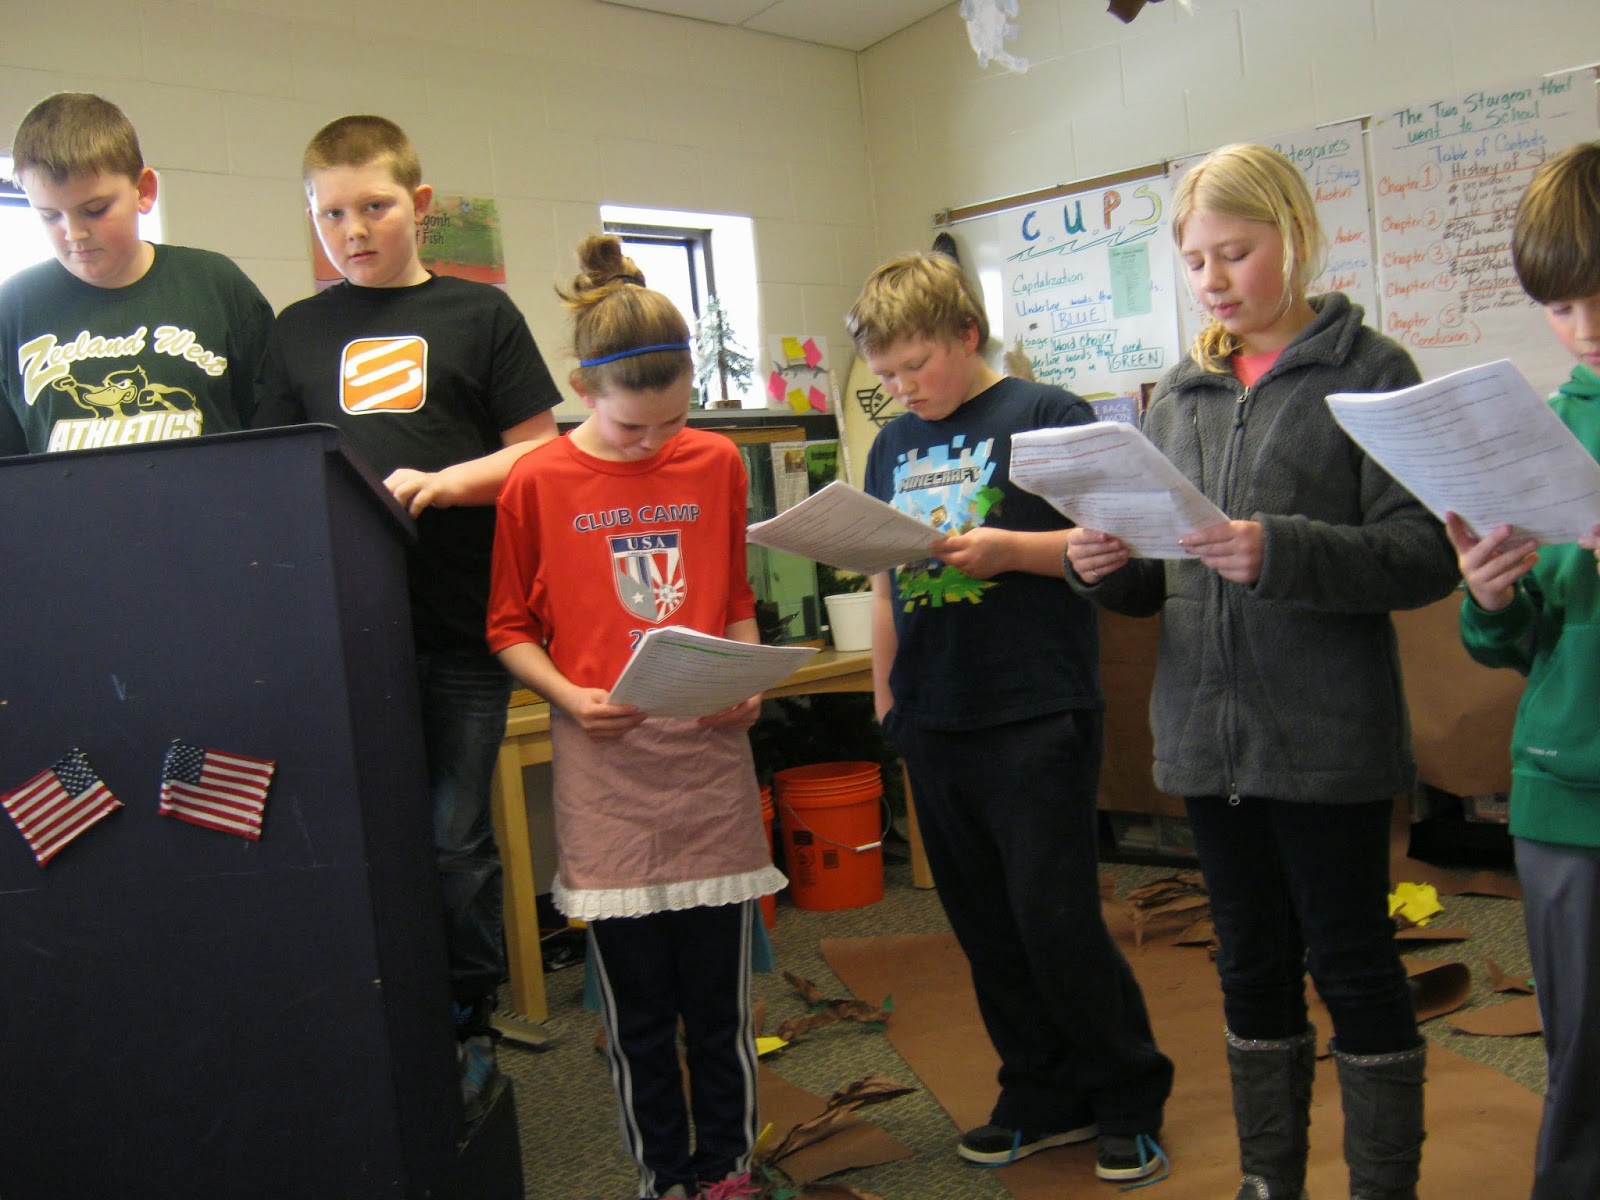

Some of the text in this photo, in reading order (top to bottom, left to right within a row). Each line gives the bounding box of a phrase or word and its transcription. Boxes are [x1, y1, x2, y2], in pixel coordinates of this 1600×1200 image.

[1393, 75, 1573, 128] The Two Sturgeon that
[1407, 100, 1540, 144] went to School
[1427, 144, 1468, 163] Table
[1475, 136, 1490, 157] of
[1451, 161, 1499, 178] History
[1503, 151, 1520, 169] of
[1378, 175, 1420, 198] Chapter
[1382, 210, 1437, 236] Chapter 2
[423, 230, 445, 245] Fish
[1383, 249, 1426, 270] Chapter
[1016, 299, 1060, 316] Underline
[1058, 308, 1100, 328] BLUE
[1387, 311, 1430, 331] Chapter
[18, 325, 228, 406] Zeeland West
[1112, 349, 1159, 370] GREEN
[1103, 403, 1130, 414] BACK
[46, 412, 204, 453] ATHLETICS
[899, 466, 981, 494] MINECRAFT
[574, 504, 700, 533] CLUB CAMP
[626, 536, 667, 551] USA
